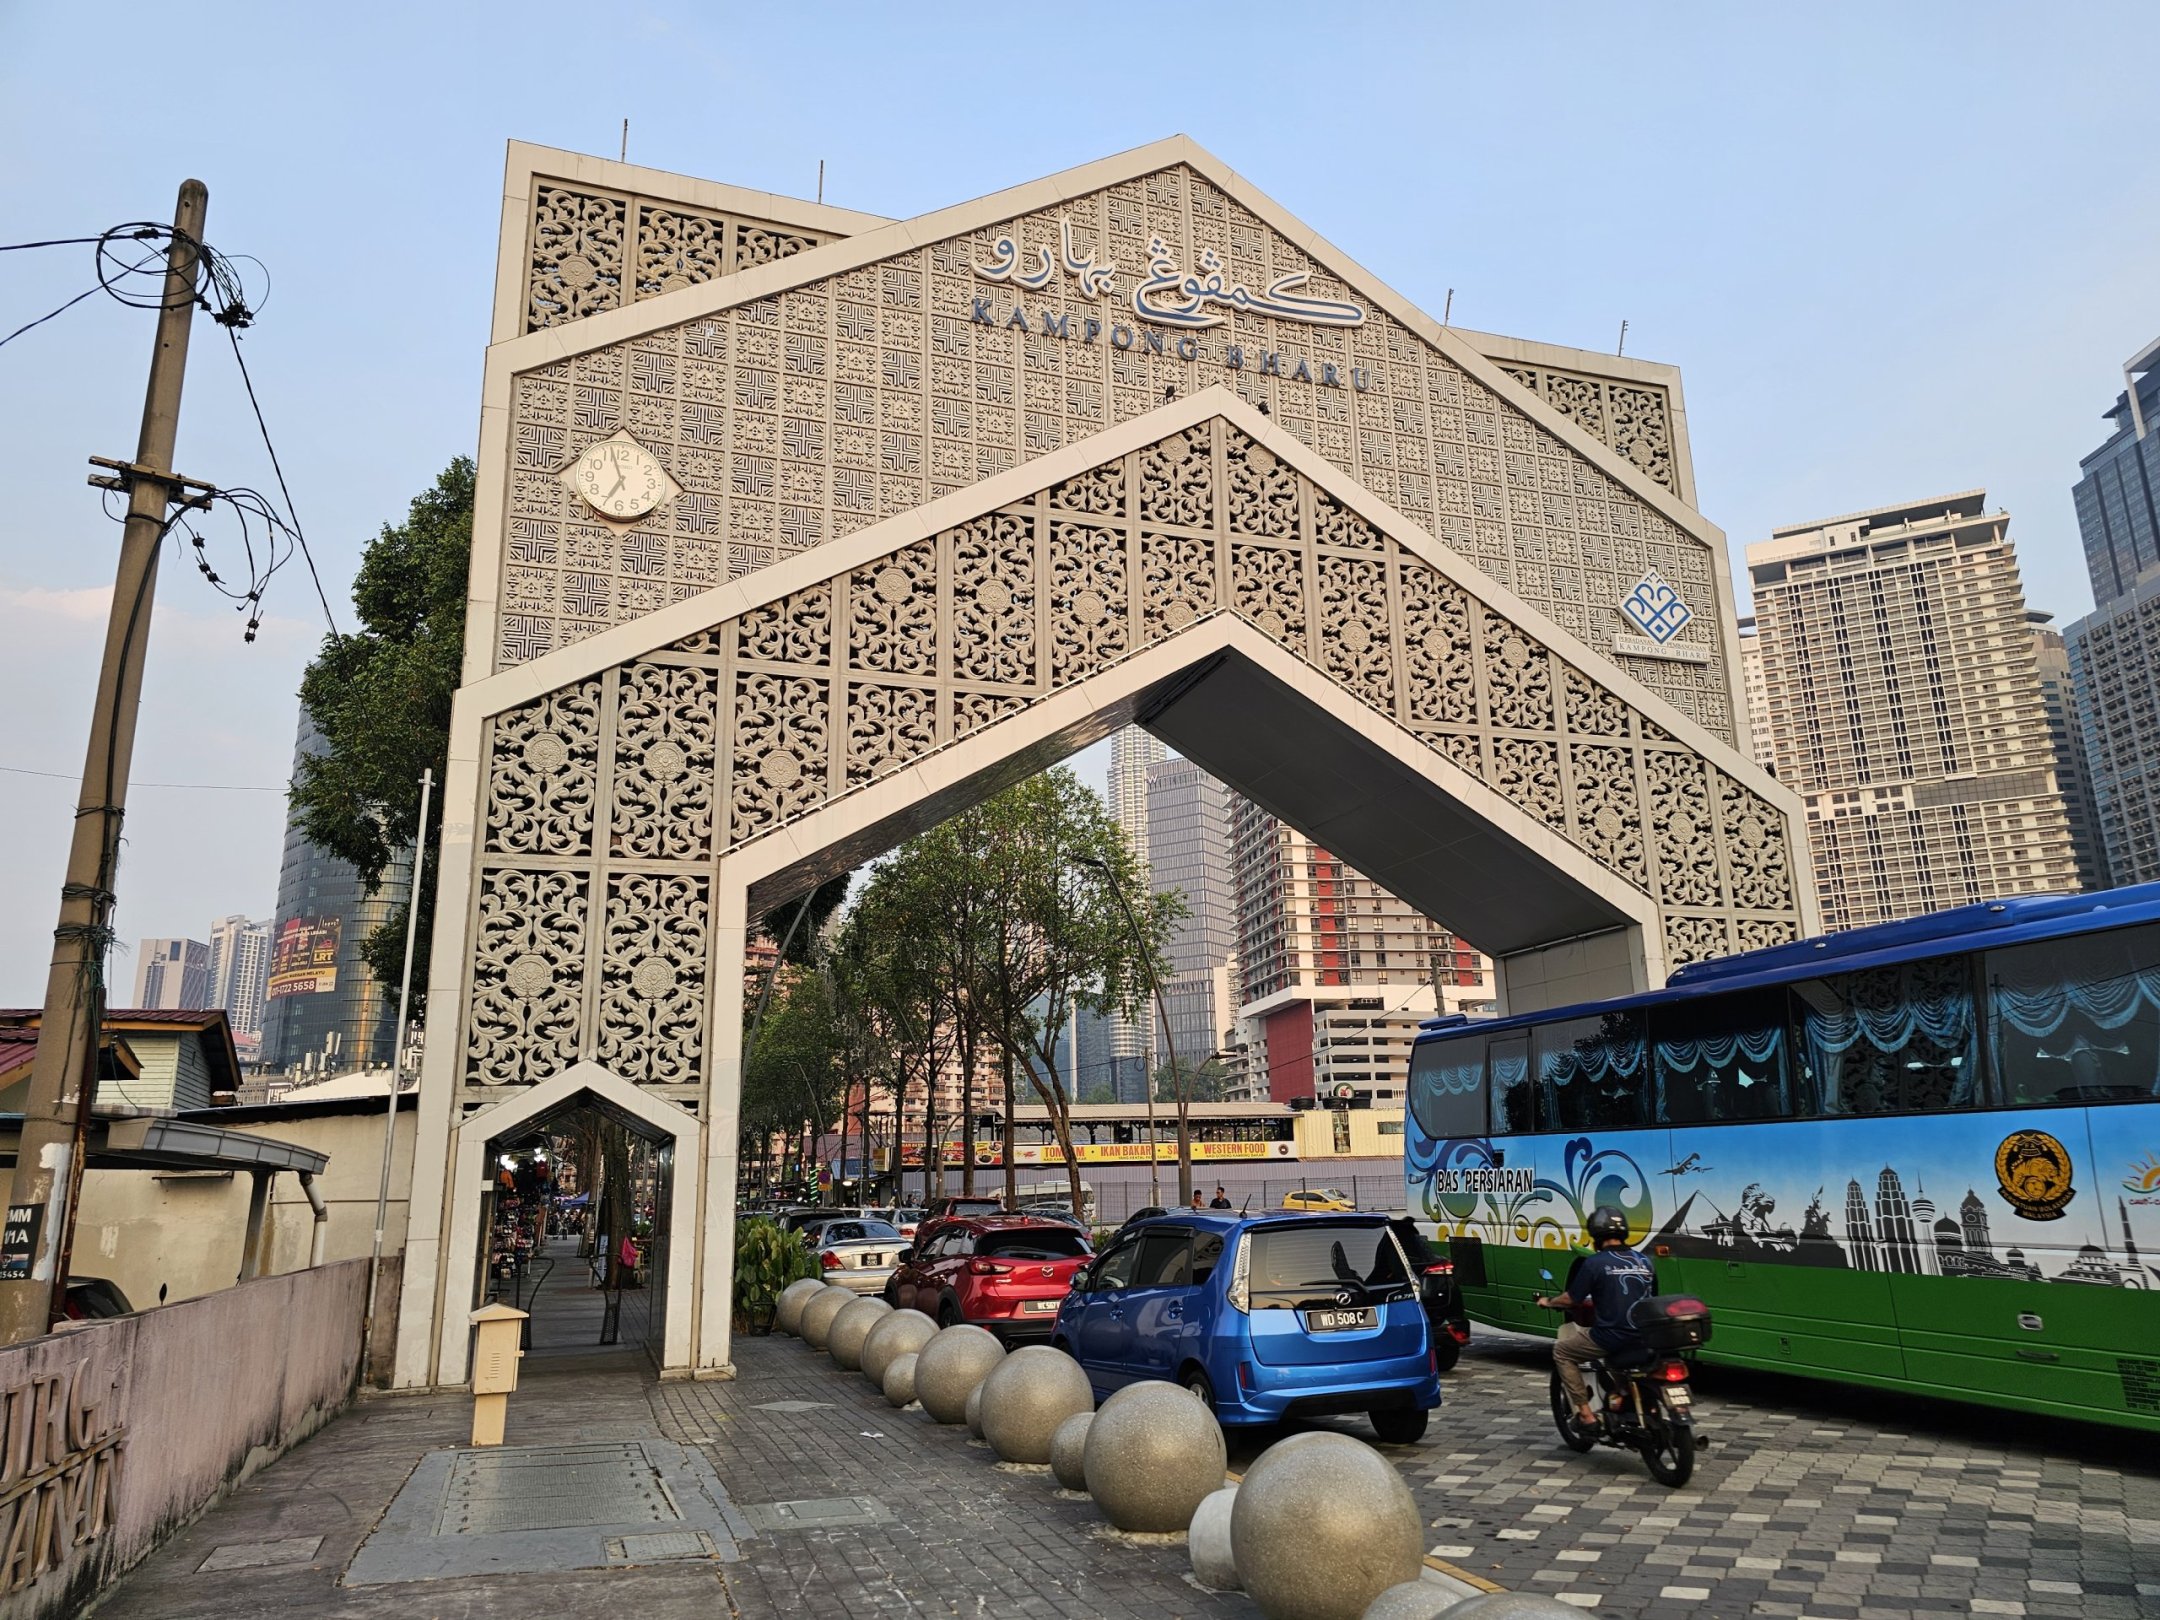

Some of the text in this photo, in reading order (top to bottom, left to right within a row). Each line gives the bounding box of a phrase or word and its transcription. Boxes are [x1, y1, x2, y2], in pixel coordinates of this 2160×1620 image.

[971, 297, 1371, 393] KAMPONG BHARU
[1619, 643, 1708, 660] KAMPONG BHARU
[1147, 773, 1158, 784] W
[313, 952, 334, 962] LRT
[293, 981, 315, 992] 5658
[1100, 1145, 1120, 1157] IKAN
[1122, 1144, 1153, 1156] BAKAR
[1203, 1143, 1243, 1154] WESTERN
[1244, 1142, 1266, 1153] FOOD
[1437, 1168, 1534, 1193] BAS PERSIARAN
[8, 1208, 32, 1223] MM
[1320, 1313, 1335, 1327] WD
